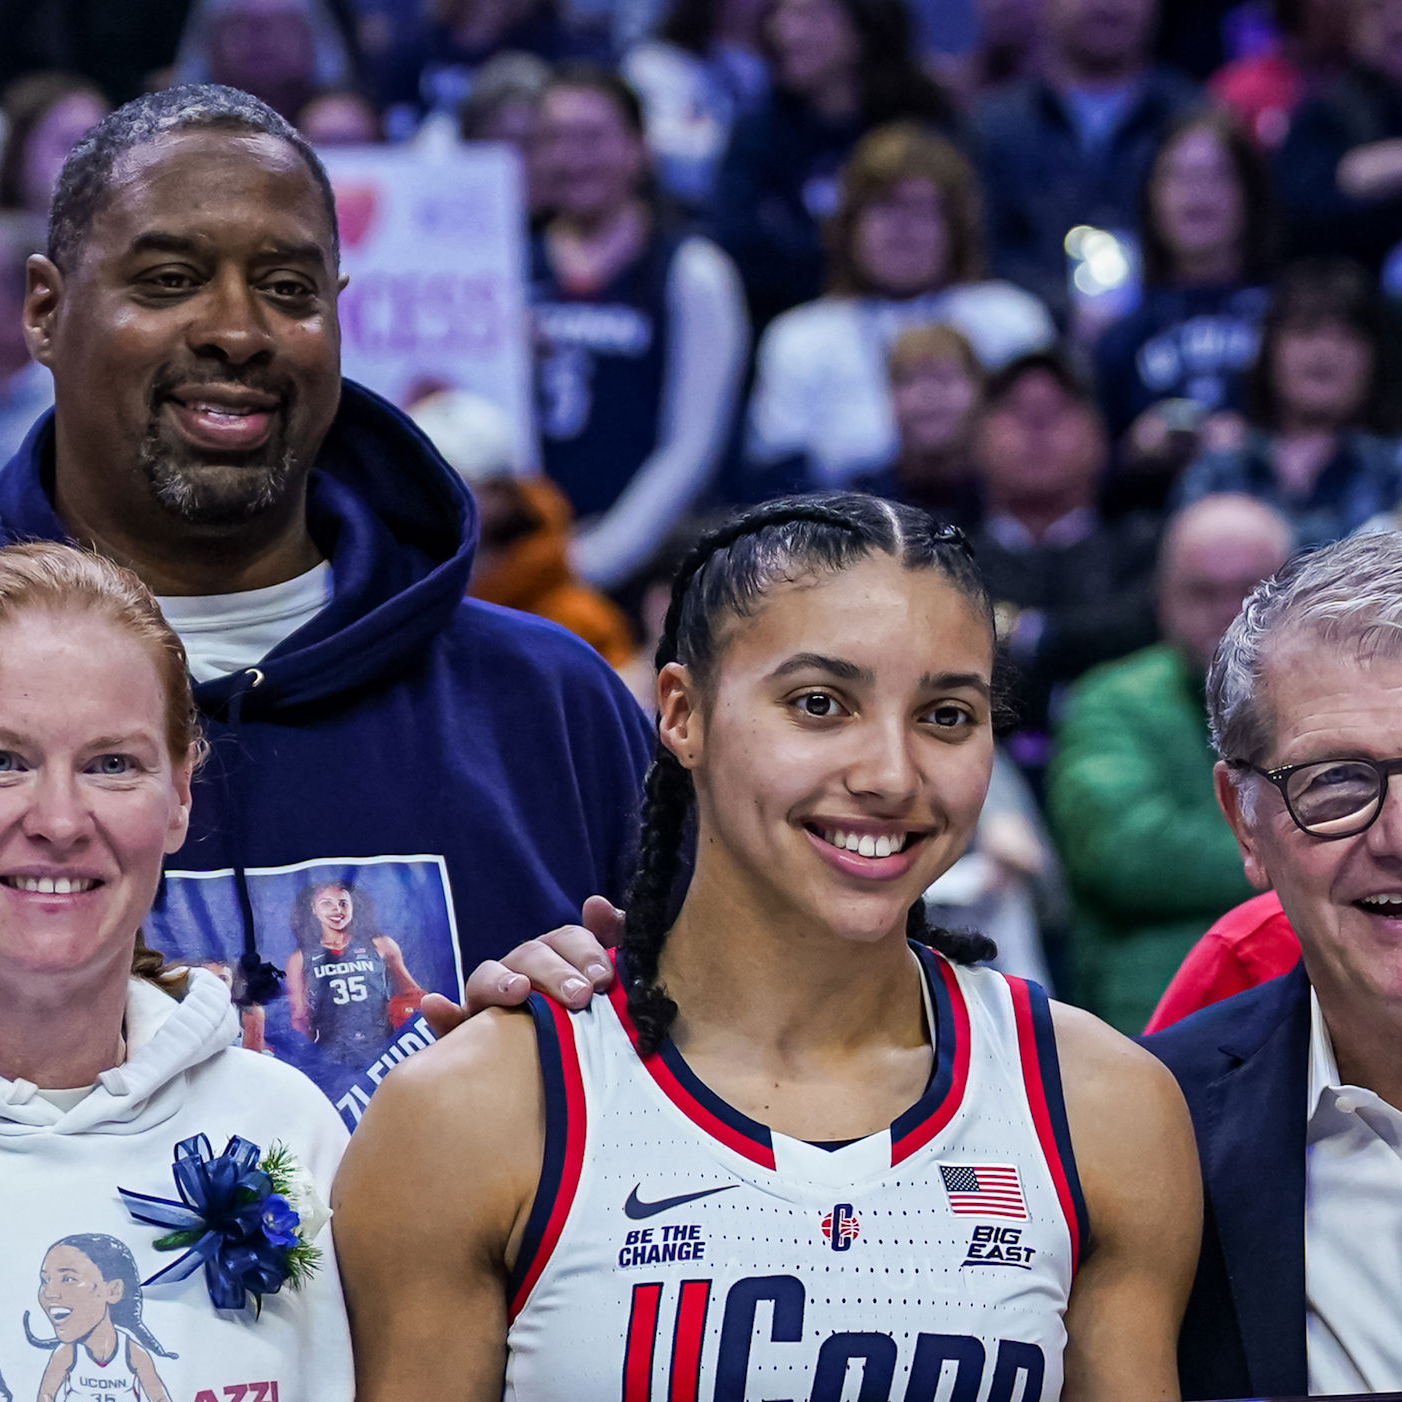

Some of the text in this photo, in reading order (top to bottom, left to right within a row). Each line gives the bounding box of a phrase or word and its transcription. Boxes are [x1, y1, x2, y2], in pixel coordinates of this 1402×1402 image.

[313, 960, 375, 979] UCONN
[329, 976, 368, 1005] 35
[625, 1225, 702, 1246] BE THE
[972, 1225, 1022, 1245] BIG
[618, 1241, 706, 1268] CHANGE
[967, 1243, 1036, 1263] EAST
[79, 1376, 126, 1389] UCONN
